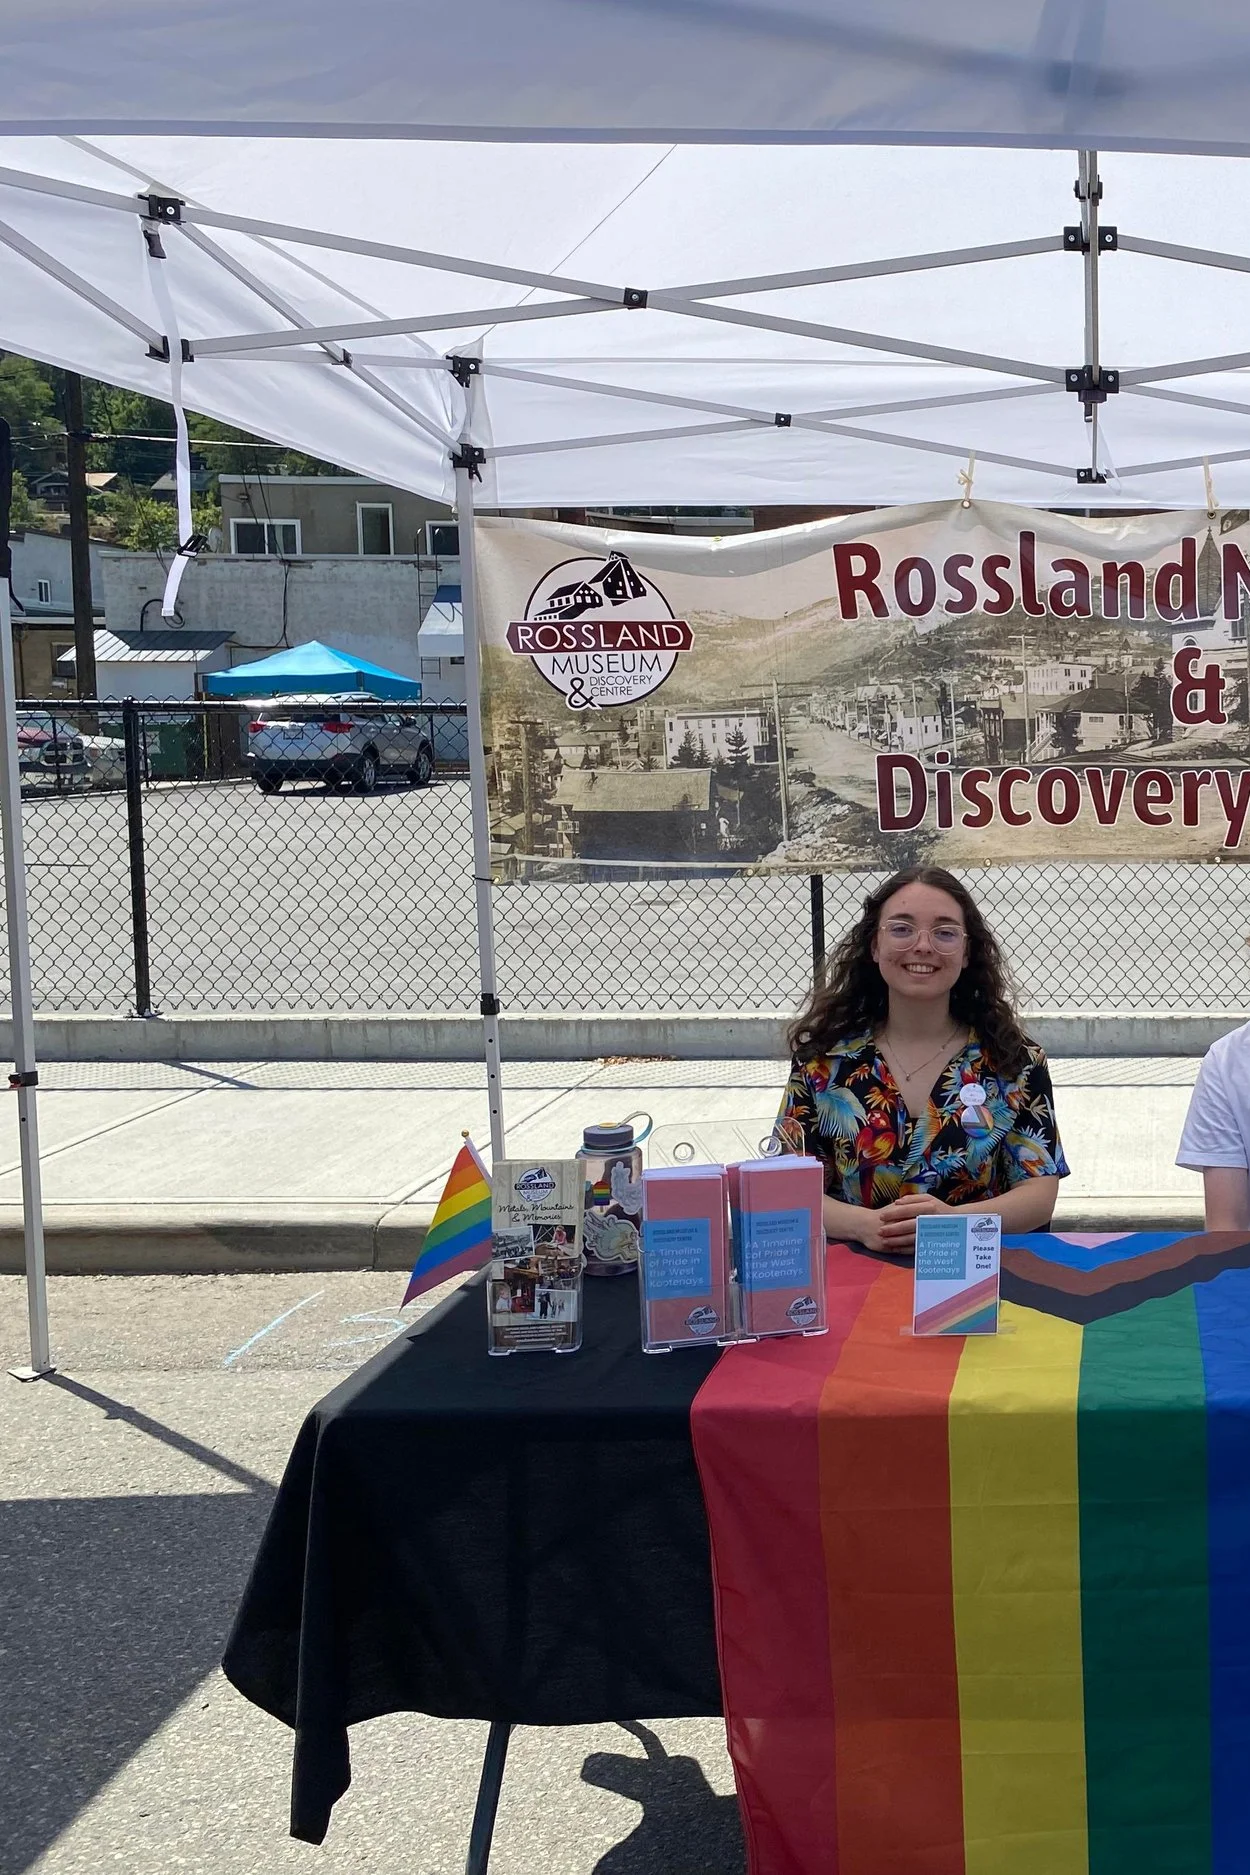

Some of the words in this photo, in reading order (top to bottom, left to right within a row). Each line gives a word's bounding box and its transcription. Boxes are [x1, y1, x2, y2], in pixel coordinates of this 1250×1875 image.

[832, 531, 1198, 621] Rossland
[517, 624, 684, 650] ROSSLAND
[551, 653, 662, 676] MUSEUM
[590, 675, 653, 686] DISCOVERY
[1170, 646, 1227, 726] &
[568, 677, 599, 709] &
[590, 686, 633, 697] CENTRE
[516, 1182, 555, 1190] ROSSLAND
[531, 1203, 574, 1211] Mountains
[523, 1213, 561, 1221] Memories
[762, 1238, 803, 1248] Timeline
[764, 1249, 789, 1258] Pride
[771, 1259, 795, 1268] West
